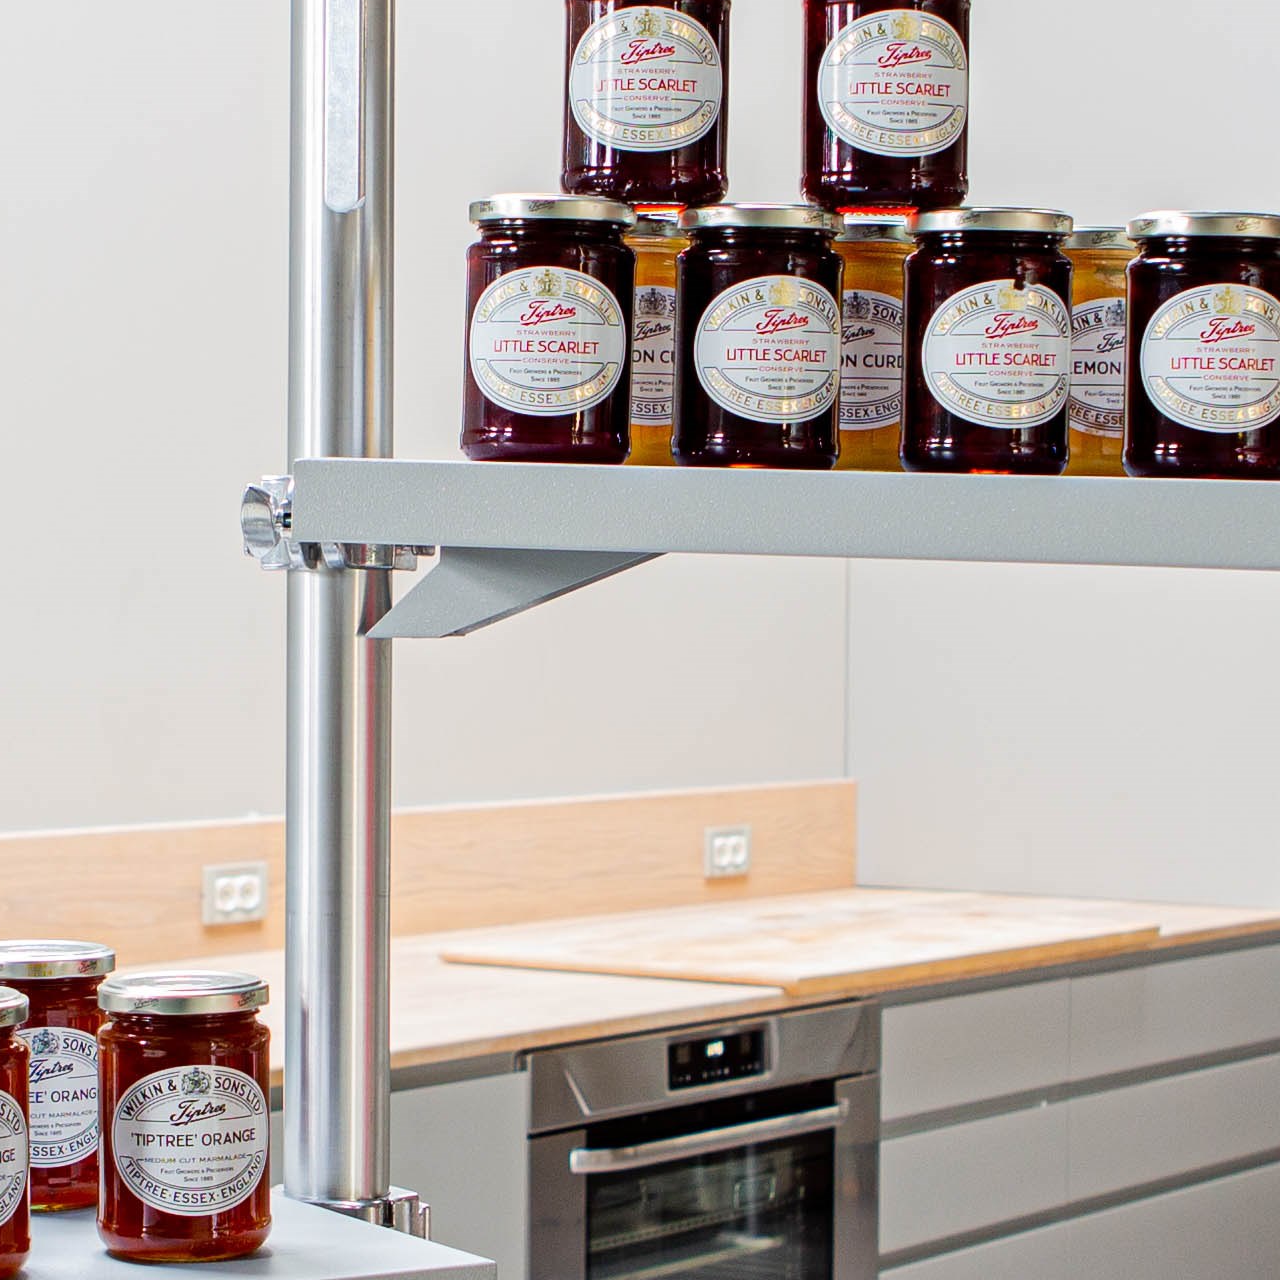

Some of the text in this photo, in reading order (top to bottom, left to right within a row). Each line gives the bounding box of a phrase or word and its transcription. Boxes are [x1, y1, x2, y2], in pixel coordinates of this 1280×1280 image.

[621, 39, 676, 64] Tiptree
[878, 42, 932, 68] Tiptree
[639, 79, 698, 93] SCARLET
[850, 82, 951, 97] LITTLE SCARLET
[520, 280, 528, 292] &
[755, 289, 764, 301] &
[800, 287, 827, 312] SONS
[984, 293, 992, 305] &
[1199, 297, 1209, 310] &
[520, 300, 576, 326] Tiptree
[756, 308, 809, 335] Tiptree
[1094, 312, 1103, 323] &
[985, 313, 1039, 339] Tiptree
[1200, 317, 1255, 343] Tiptree
[494, 340, 599, 354] LITTLE SCARLET
[727, 348, 770, 362] LITTLE
[773, 349, 828, 363] SCARLET
[956, 353, 1057, 367] LITTLE SCARLET
[1072, 360, 1122, 375] EMON
[1172, 357, 1276, 372] LITTLE SCARLET
[63, 1037, 93, 1057] SONS
[51, 1087, 97, 1103] ORANG
[122, 1076, 261, 1117] WILKIN & SONS LTD
[6, 1107, 21, 1132] LTD
[169, 1099, 226, 1126] Tiptree
[131, 1127, 256, 1147] 'TIPTREE' ORANGE
[125, 1155, 261, 1204] TIPTREE ESSEX ENGLAND
